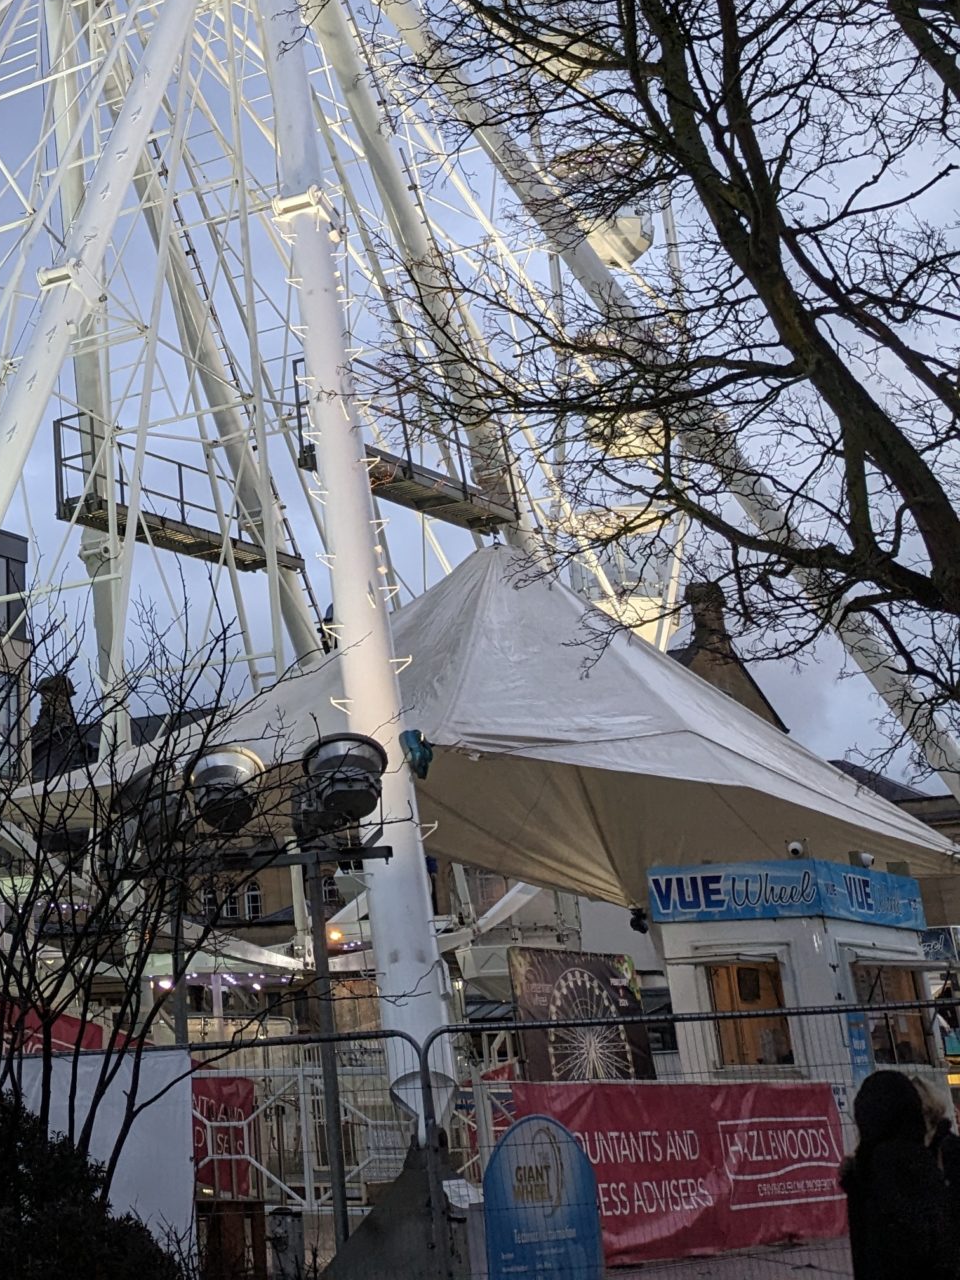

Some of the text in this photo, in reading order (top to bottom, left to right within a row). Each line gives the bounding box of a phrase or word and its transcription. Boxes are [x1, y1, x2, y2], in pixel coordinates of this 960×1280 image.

[650, 871, 817, 913] VUE Wheel
[842, 873, 875, 914] VUE
[666, 1129, 700, 1162] AND
[726, 1127, 830, 1164] HAZLEWOODS
[512, 1183, 553, 1202] WHEEL
[515, 1164, 551, 1184] GIANT
[597, 1177, 714, 1217] ESS ADVISERS
